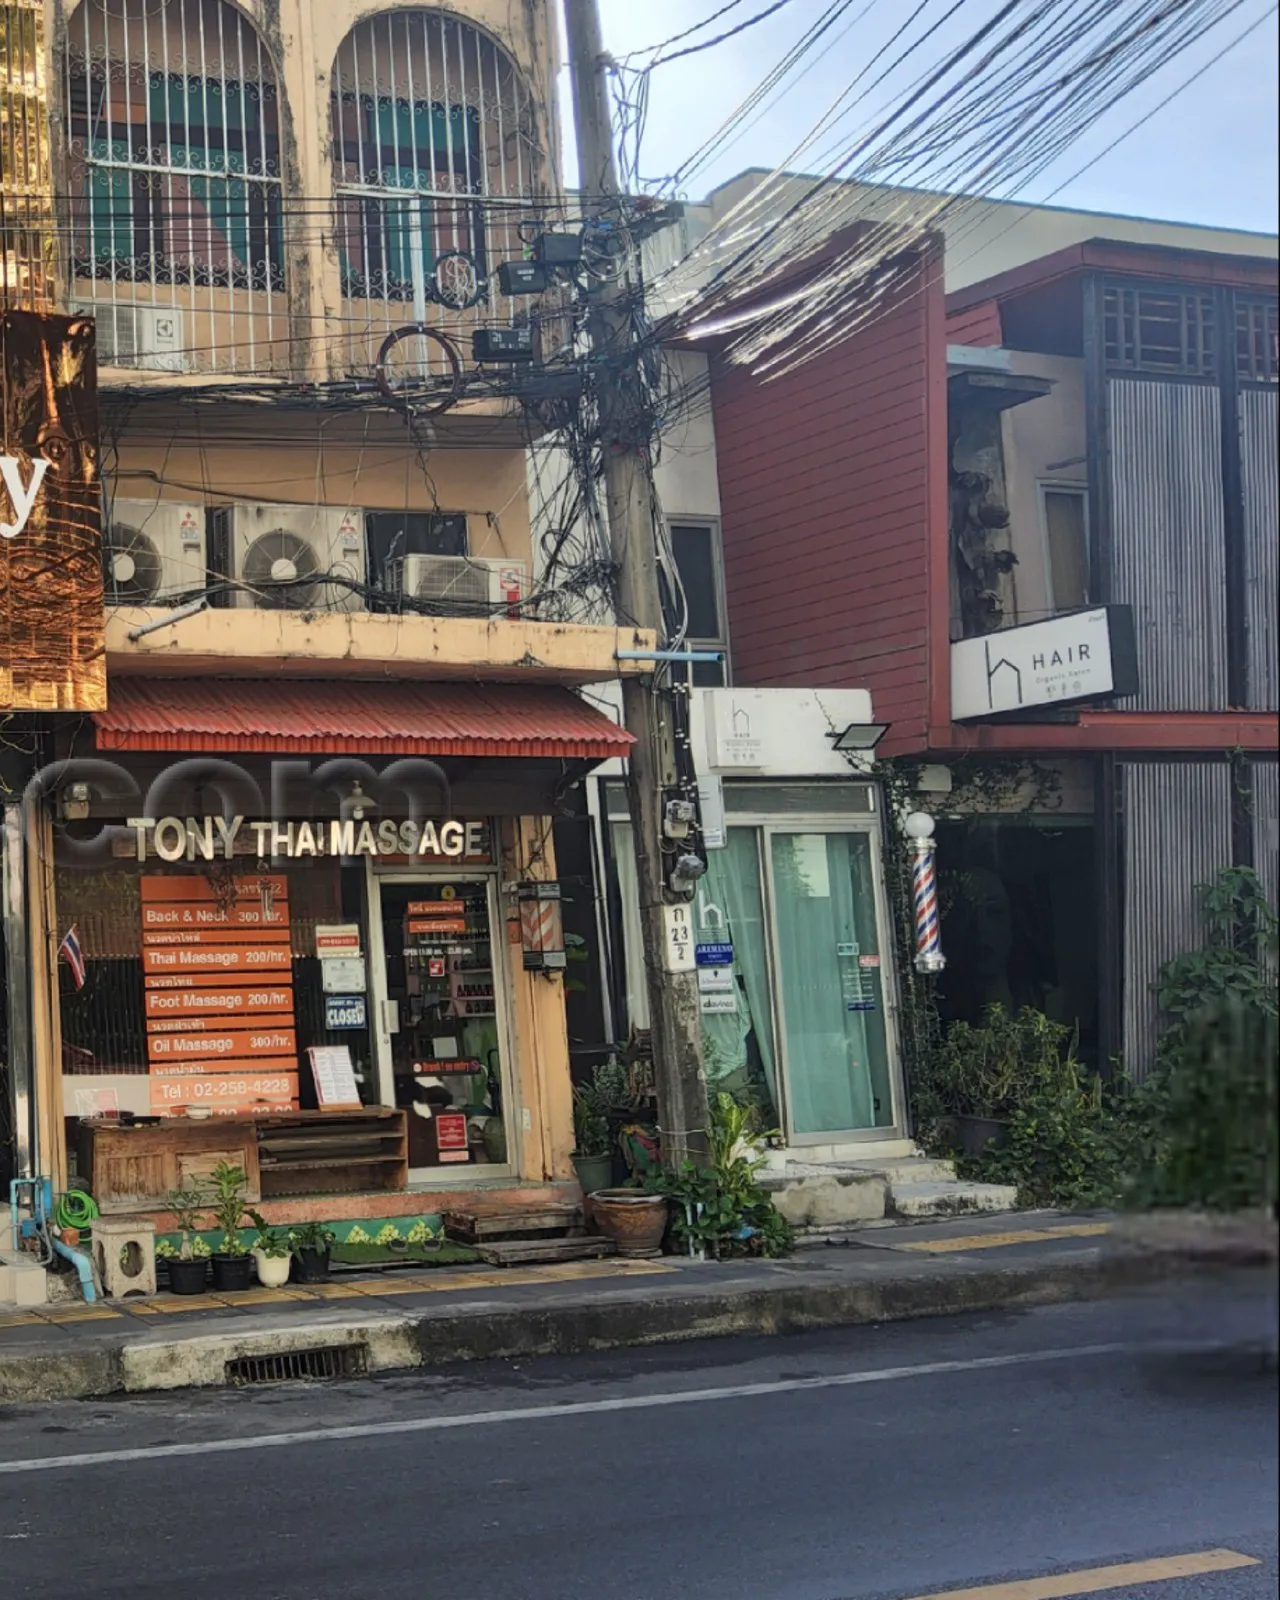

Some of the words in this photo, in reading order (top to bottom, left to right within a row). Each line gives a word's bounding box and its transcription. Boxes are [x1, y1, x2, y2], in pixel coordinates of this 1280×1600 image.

[1032, 644, 1091, 670] HAIR
[126, 815, 244, 862] TONY
[250, 821, 324, 858] THAI
[330, 819, 483, 856] MASSAGE
[146, 910, 179, 922] Back
[183, 910, 193, 922] &
[197, 909, 228, 922] Neck
[671, 926, 688, 942] 23
[149, 952, 176, 964] Thai
[179, 951, 239, 966] Massage
[246, 950, 286, 963] 200/hr.
[677, 945, 685, 960] 2
[150, 996, 180, 1008] Foot
[184, 994, 242, 1008] Massage
[248, 992, 288, 1005] 200/hr.
[153, 1040, 170, 1053] Oil
[173, 1038, 233, 1053] Massage
[250, 1035, 291, 1048] 300/hr.
[161, 1084, 181, 1099] Tel
[194, 1079, 290, 1097] 02-258-4228
